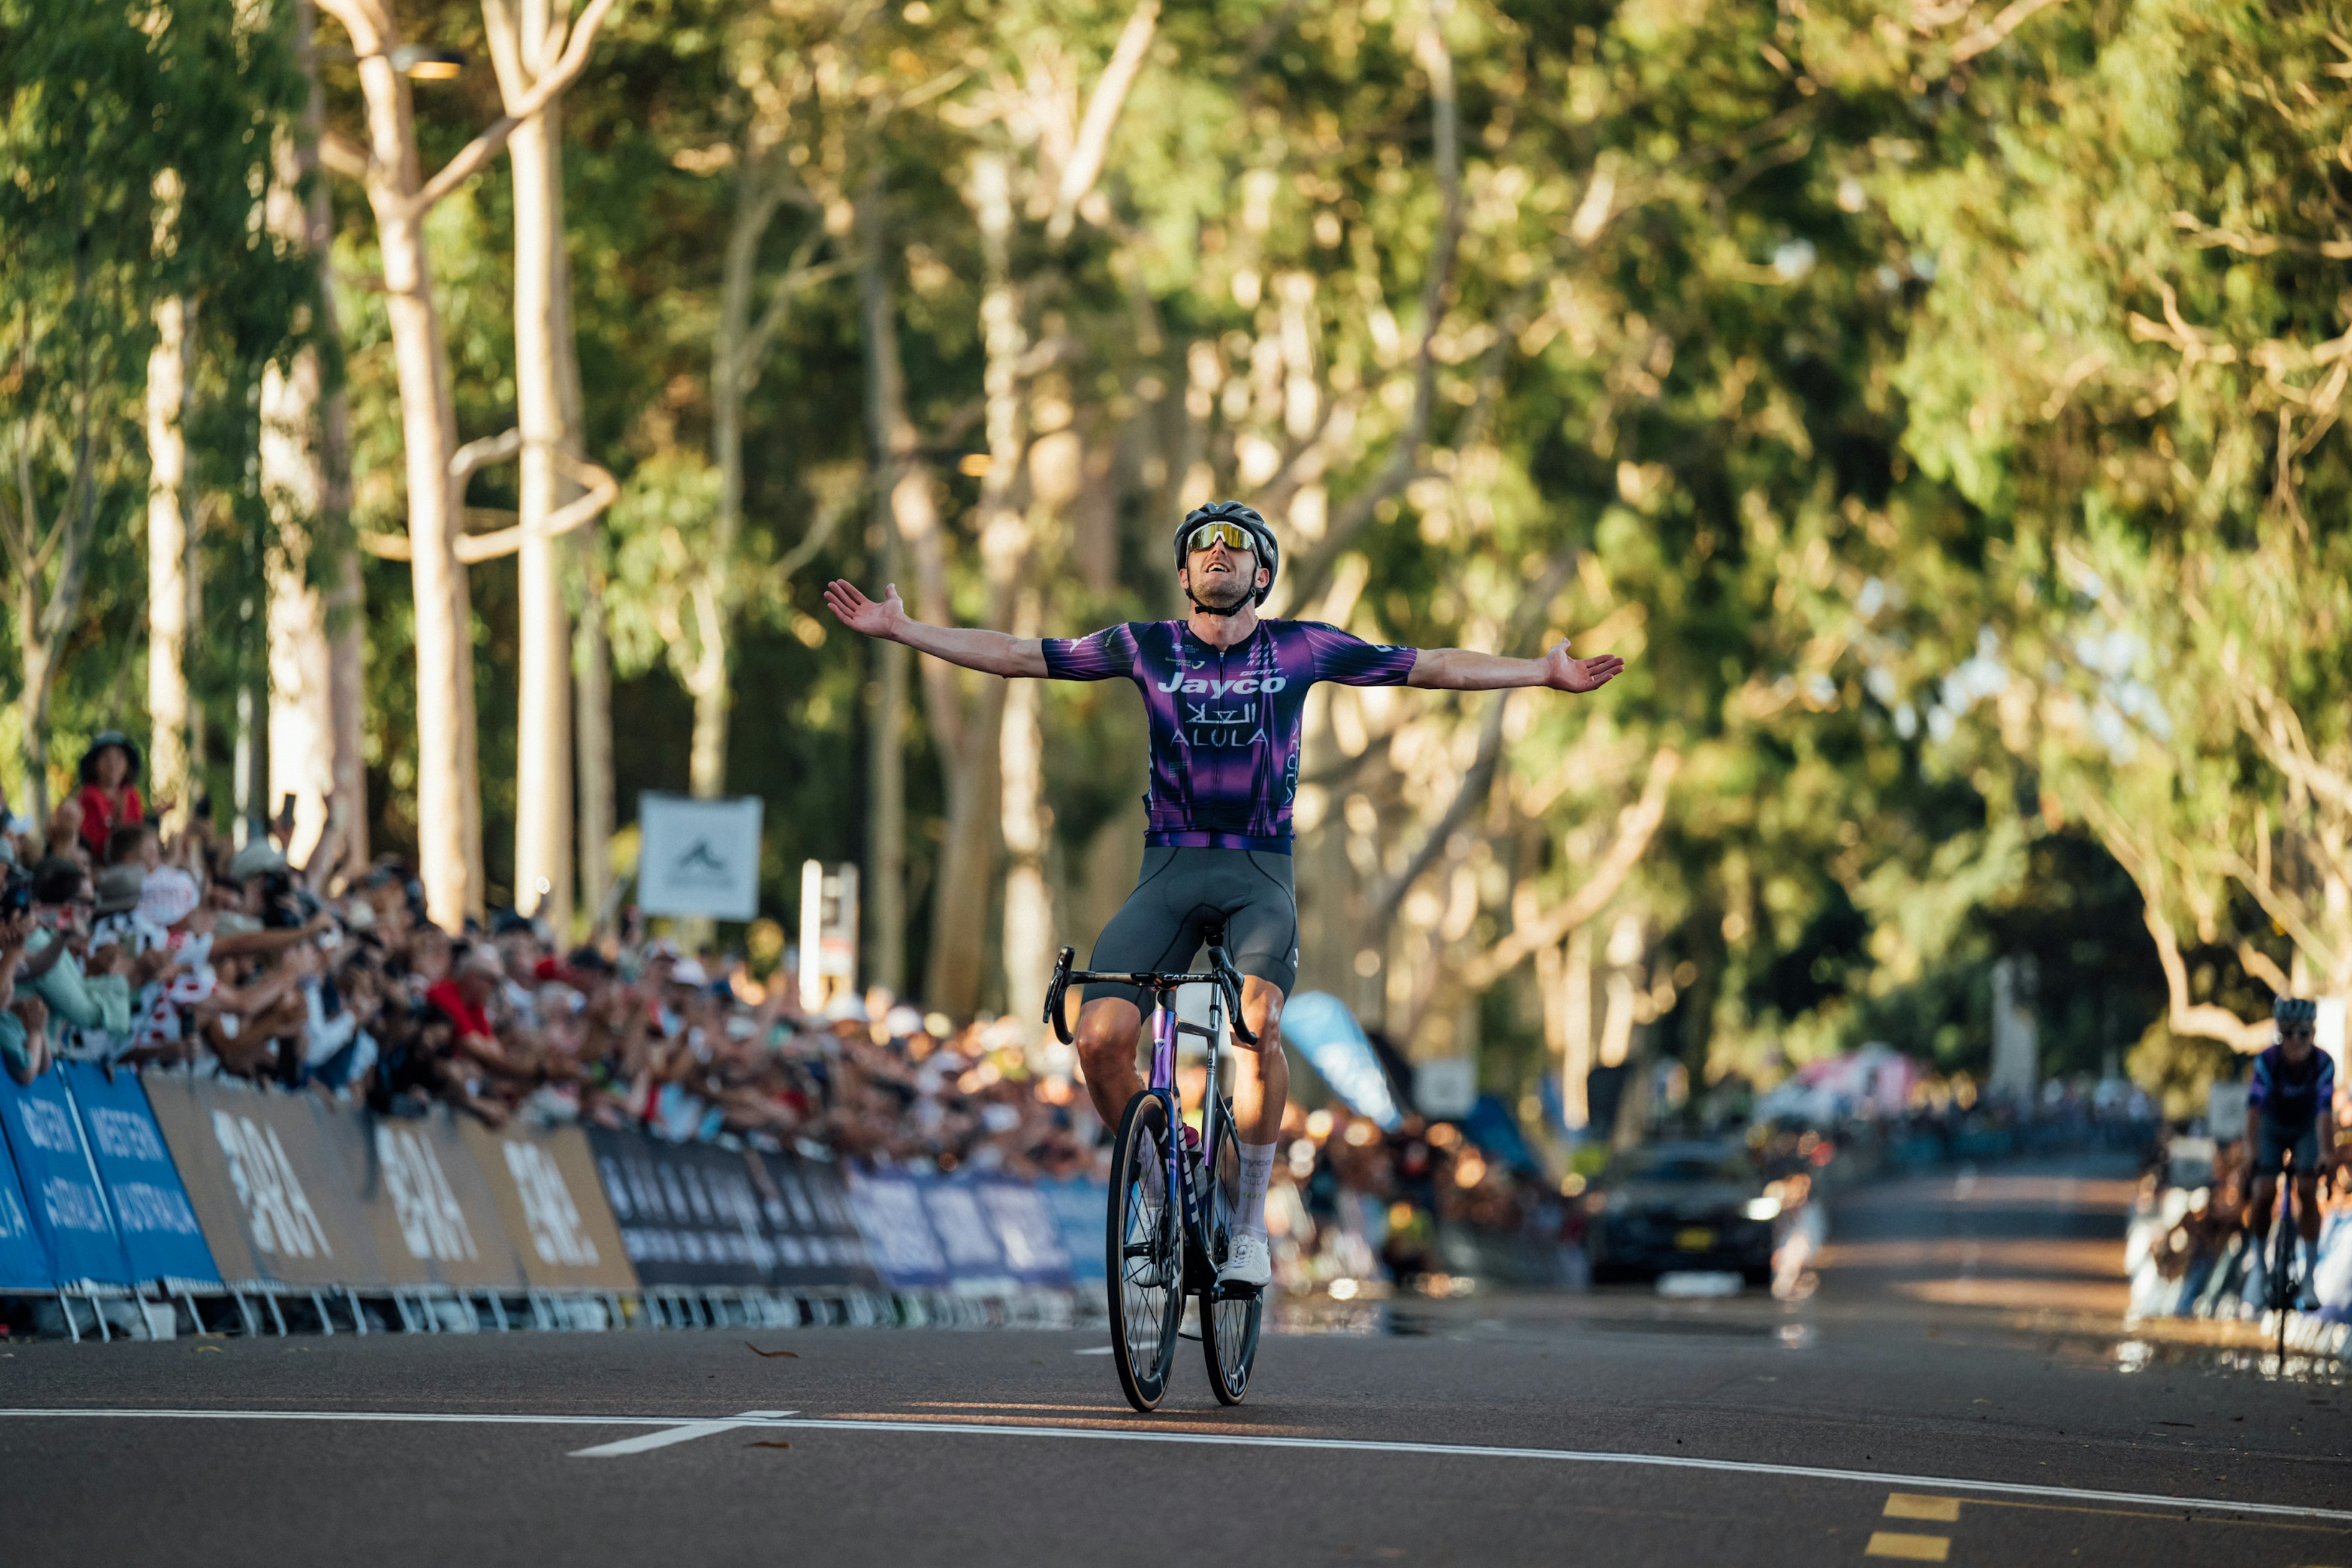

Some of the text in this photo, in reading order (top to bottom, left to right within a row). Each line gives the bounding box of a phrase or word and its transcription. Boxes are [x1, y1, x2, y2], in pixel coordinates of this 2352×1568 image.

[1248, 641, 1277, 651] MAAP
[1247, 649, 1277, 659] MAAP
[1246, 657, 1277, 666] MAAP
[1239, 668, 1283, 676] GIANT
[1157, 672, 1286, 699] Jayco
[1170, 727, 1269, 747] ALULA
